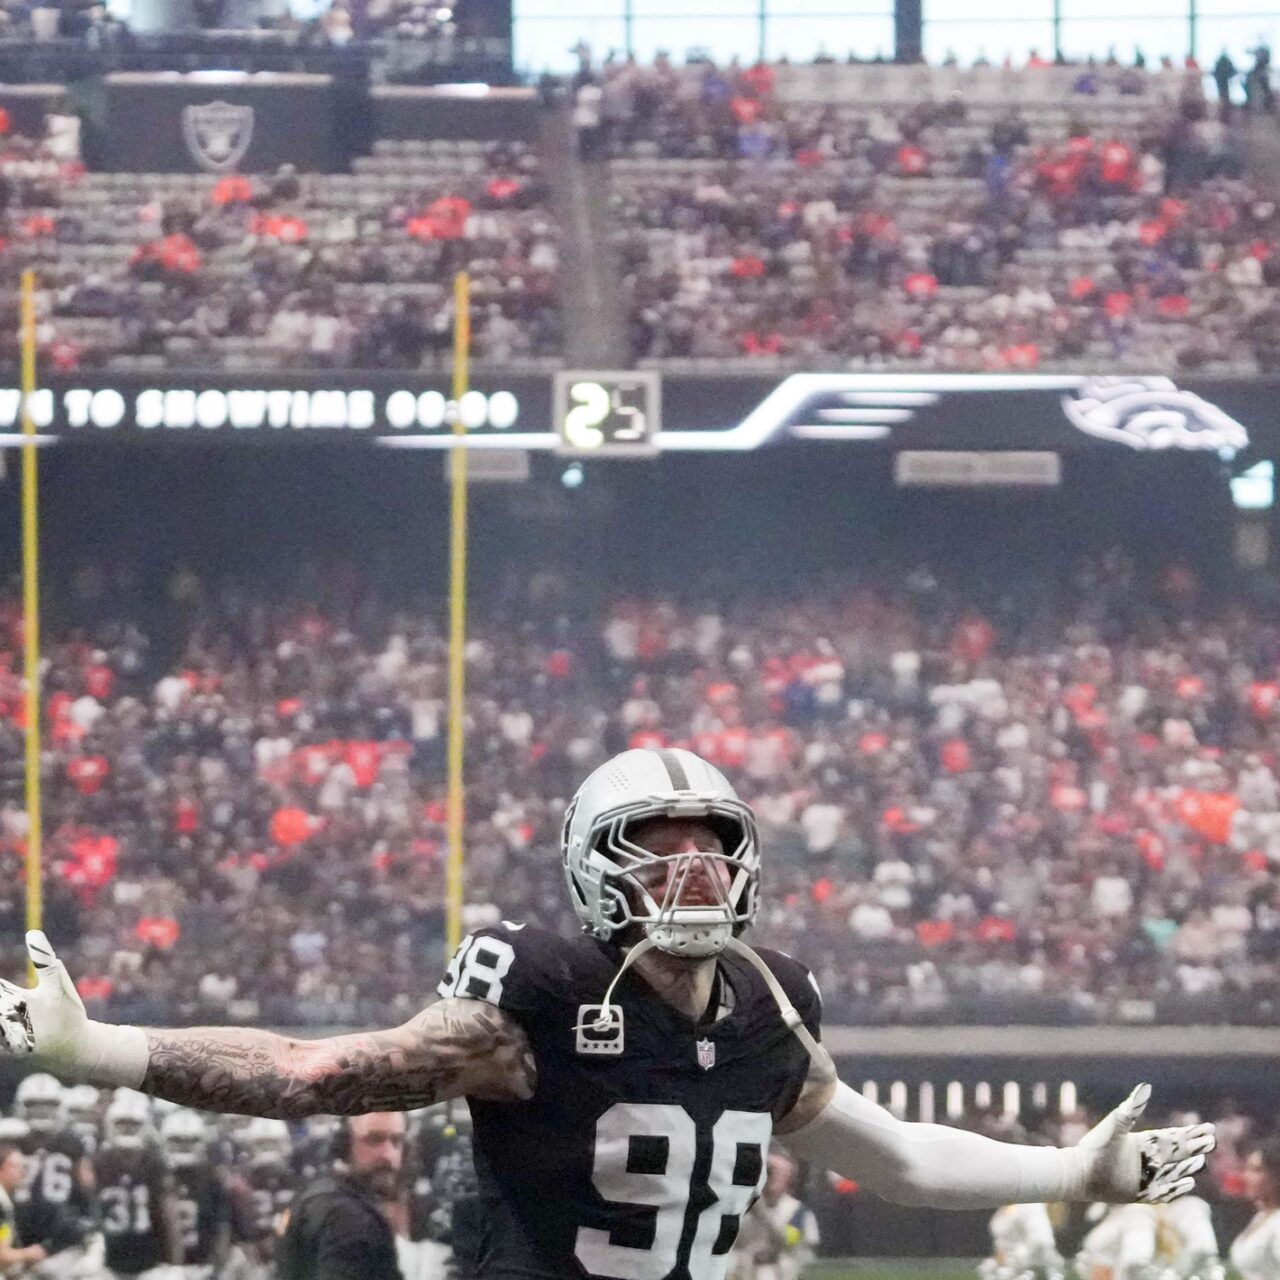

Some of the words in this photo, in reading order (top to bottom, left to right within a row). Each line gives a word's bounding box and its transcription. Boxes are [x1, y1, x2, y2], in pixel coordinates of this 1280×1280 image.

[64, 388, 125, 428] TO
[135, 389, 375, 429] SHOWTIME
[386, 390, 518, 430] 00:00
[565, 382, 646, 447] 25
[437, 935, 516, 1007] 98
[100, 1184, 151, 1233] 31
